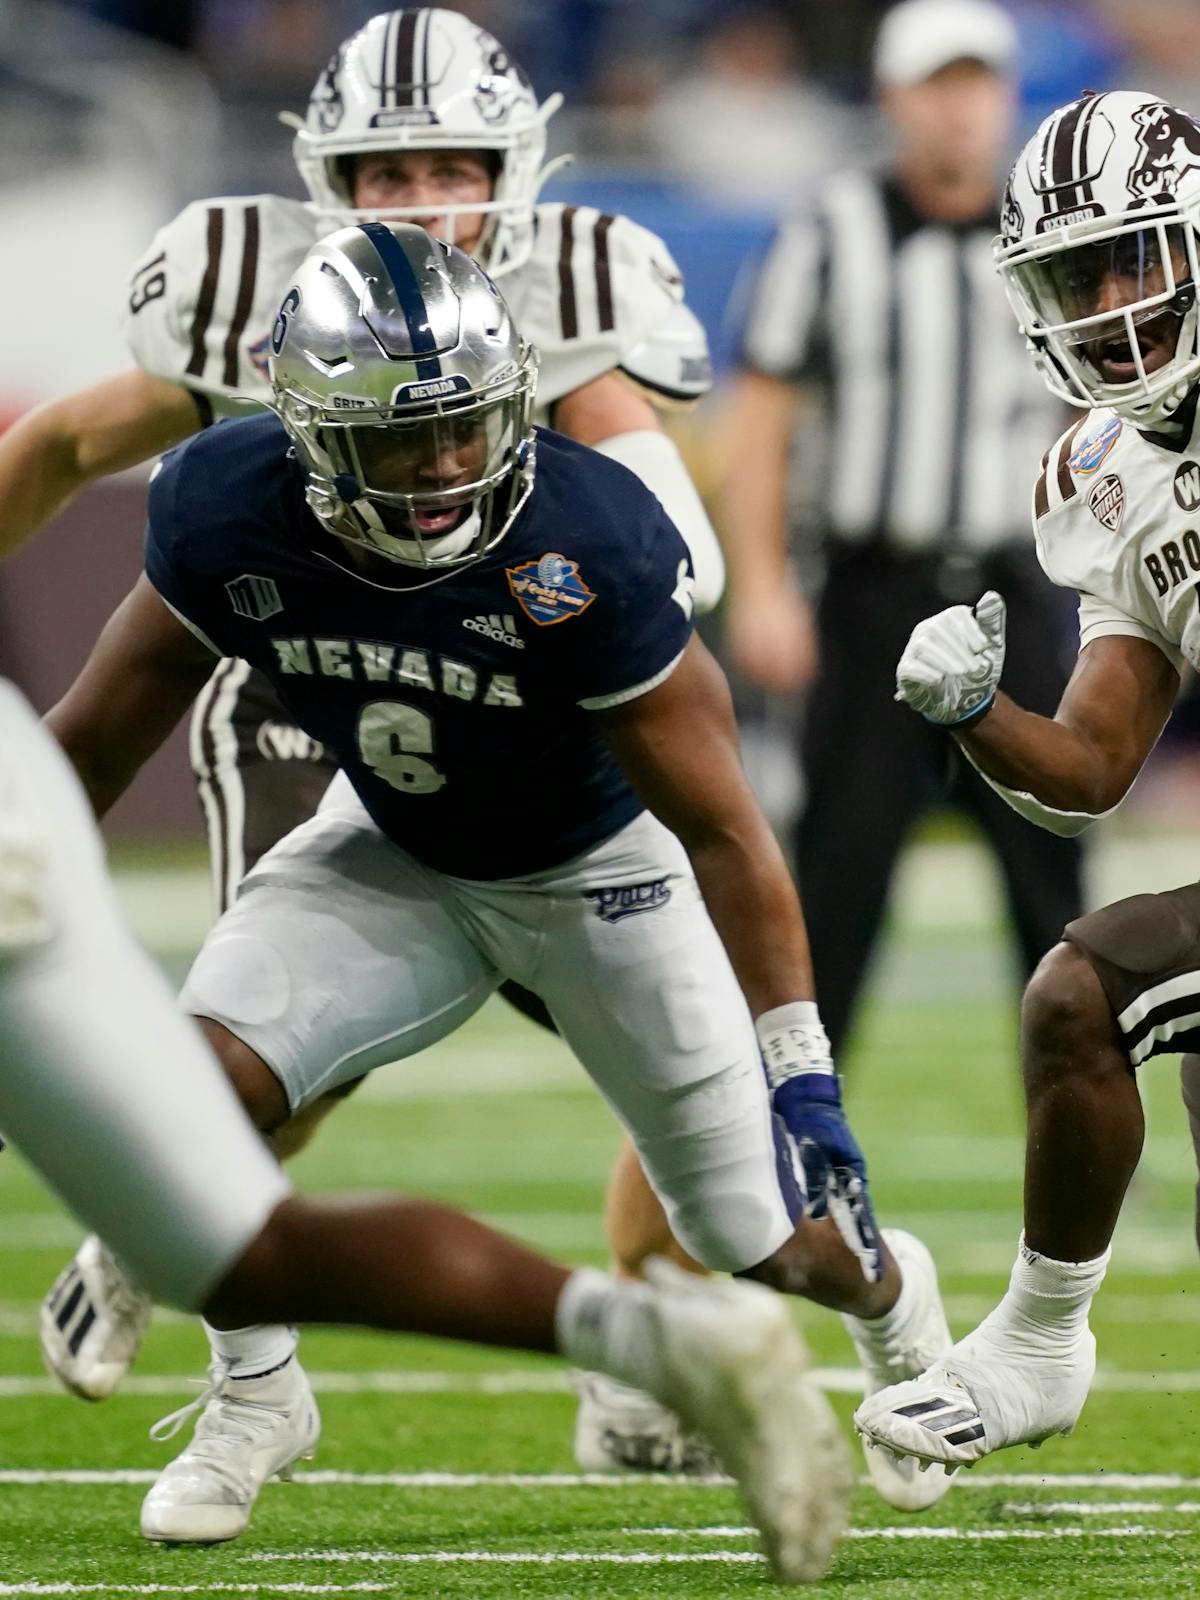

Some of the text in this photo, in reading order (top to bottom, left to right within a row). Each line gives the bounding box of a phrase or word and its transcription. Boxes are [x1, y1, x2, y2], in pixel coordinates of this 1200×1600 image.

[1043, 207, 1095, 233] OXFORD
[129, 250, 166, 314] 19
[333, 397, 365, 408] GRIT
[408, 380, 457, 400] NEVADA
[1174, 465, 1200, 507] W
[461, 617, 526, 650] adidas
[271, 636, 524, 707] NEVADA
[358, 701, 447, 794] 6
